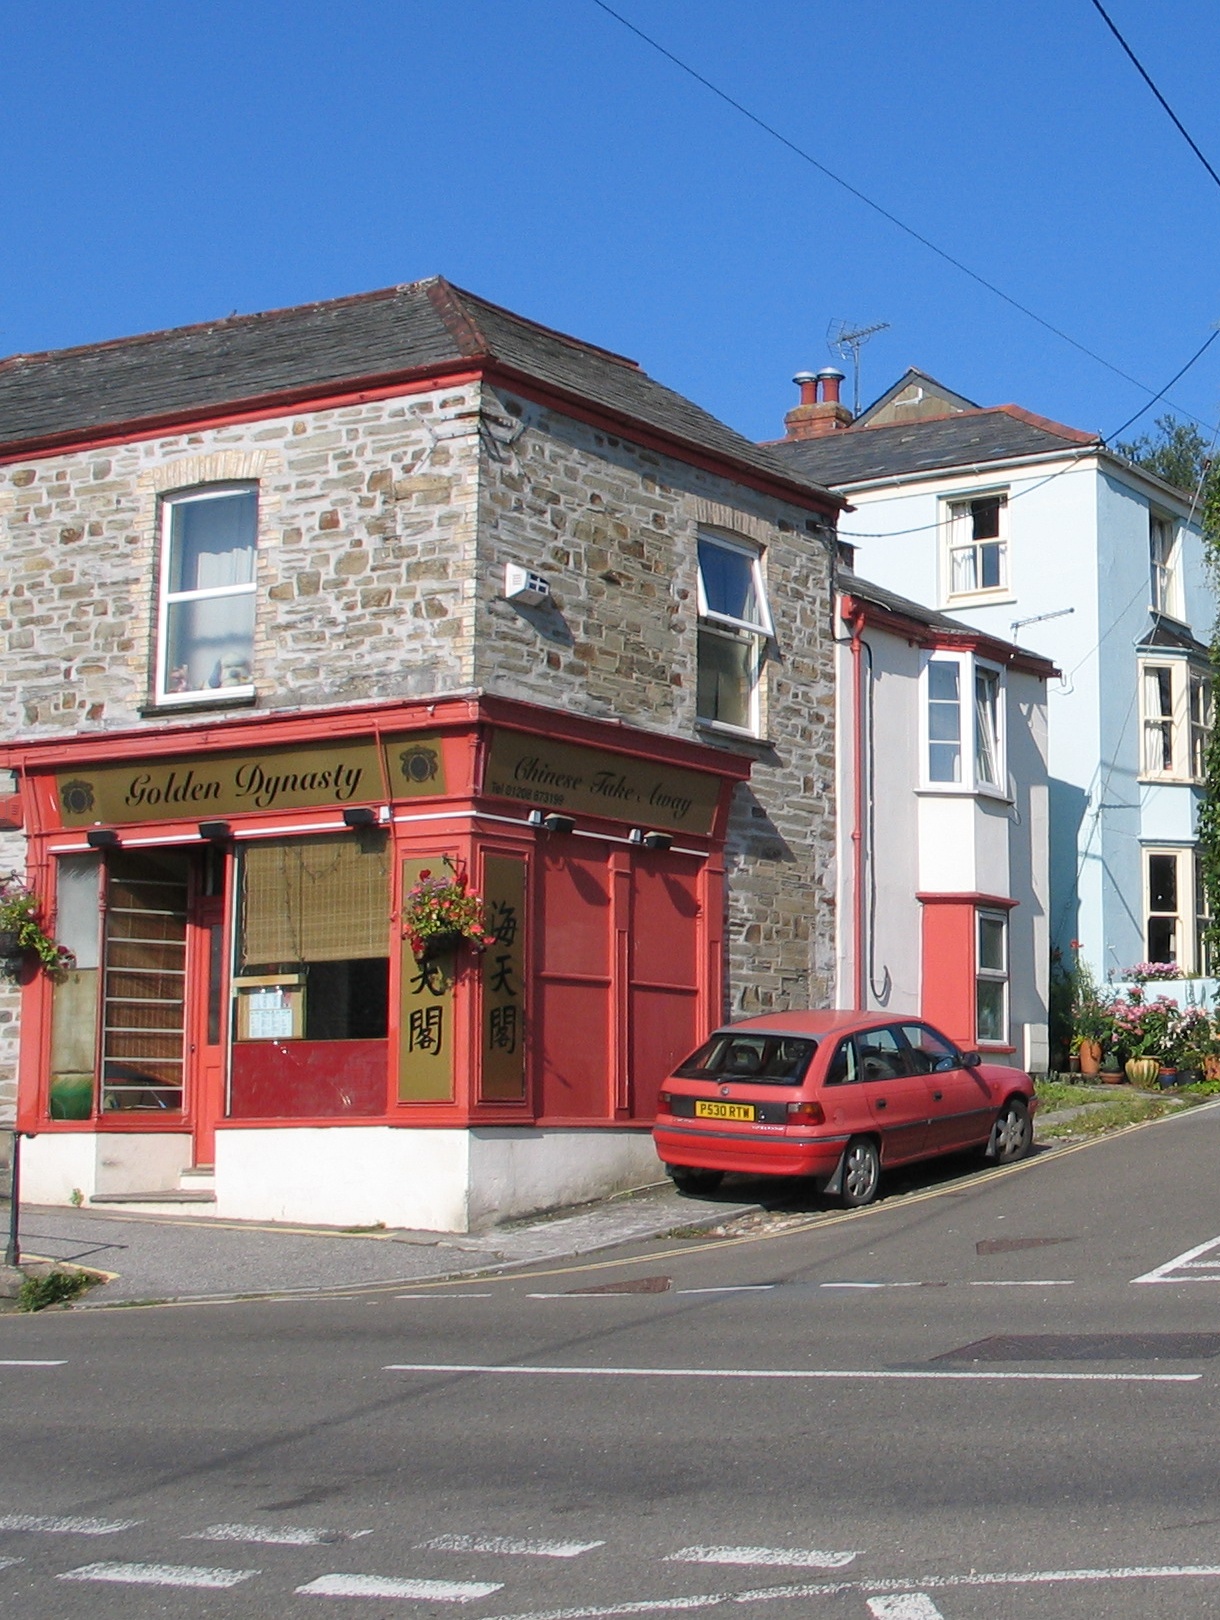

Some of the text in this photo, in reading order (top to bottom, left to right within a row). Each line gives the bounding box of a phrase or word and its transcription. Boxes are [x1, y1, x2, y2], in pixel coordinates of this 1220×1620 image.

[125, 763, 363, 808] Golden Dynasty
[513, 755, 692, 819] Chinese Take Away
[409, 962, 444, 1057] 天閣
[490, 900, 517, 1055] 海天閣
[700, 1102, 750, 1119] P530 RTW
